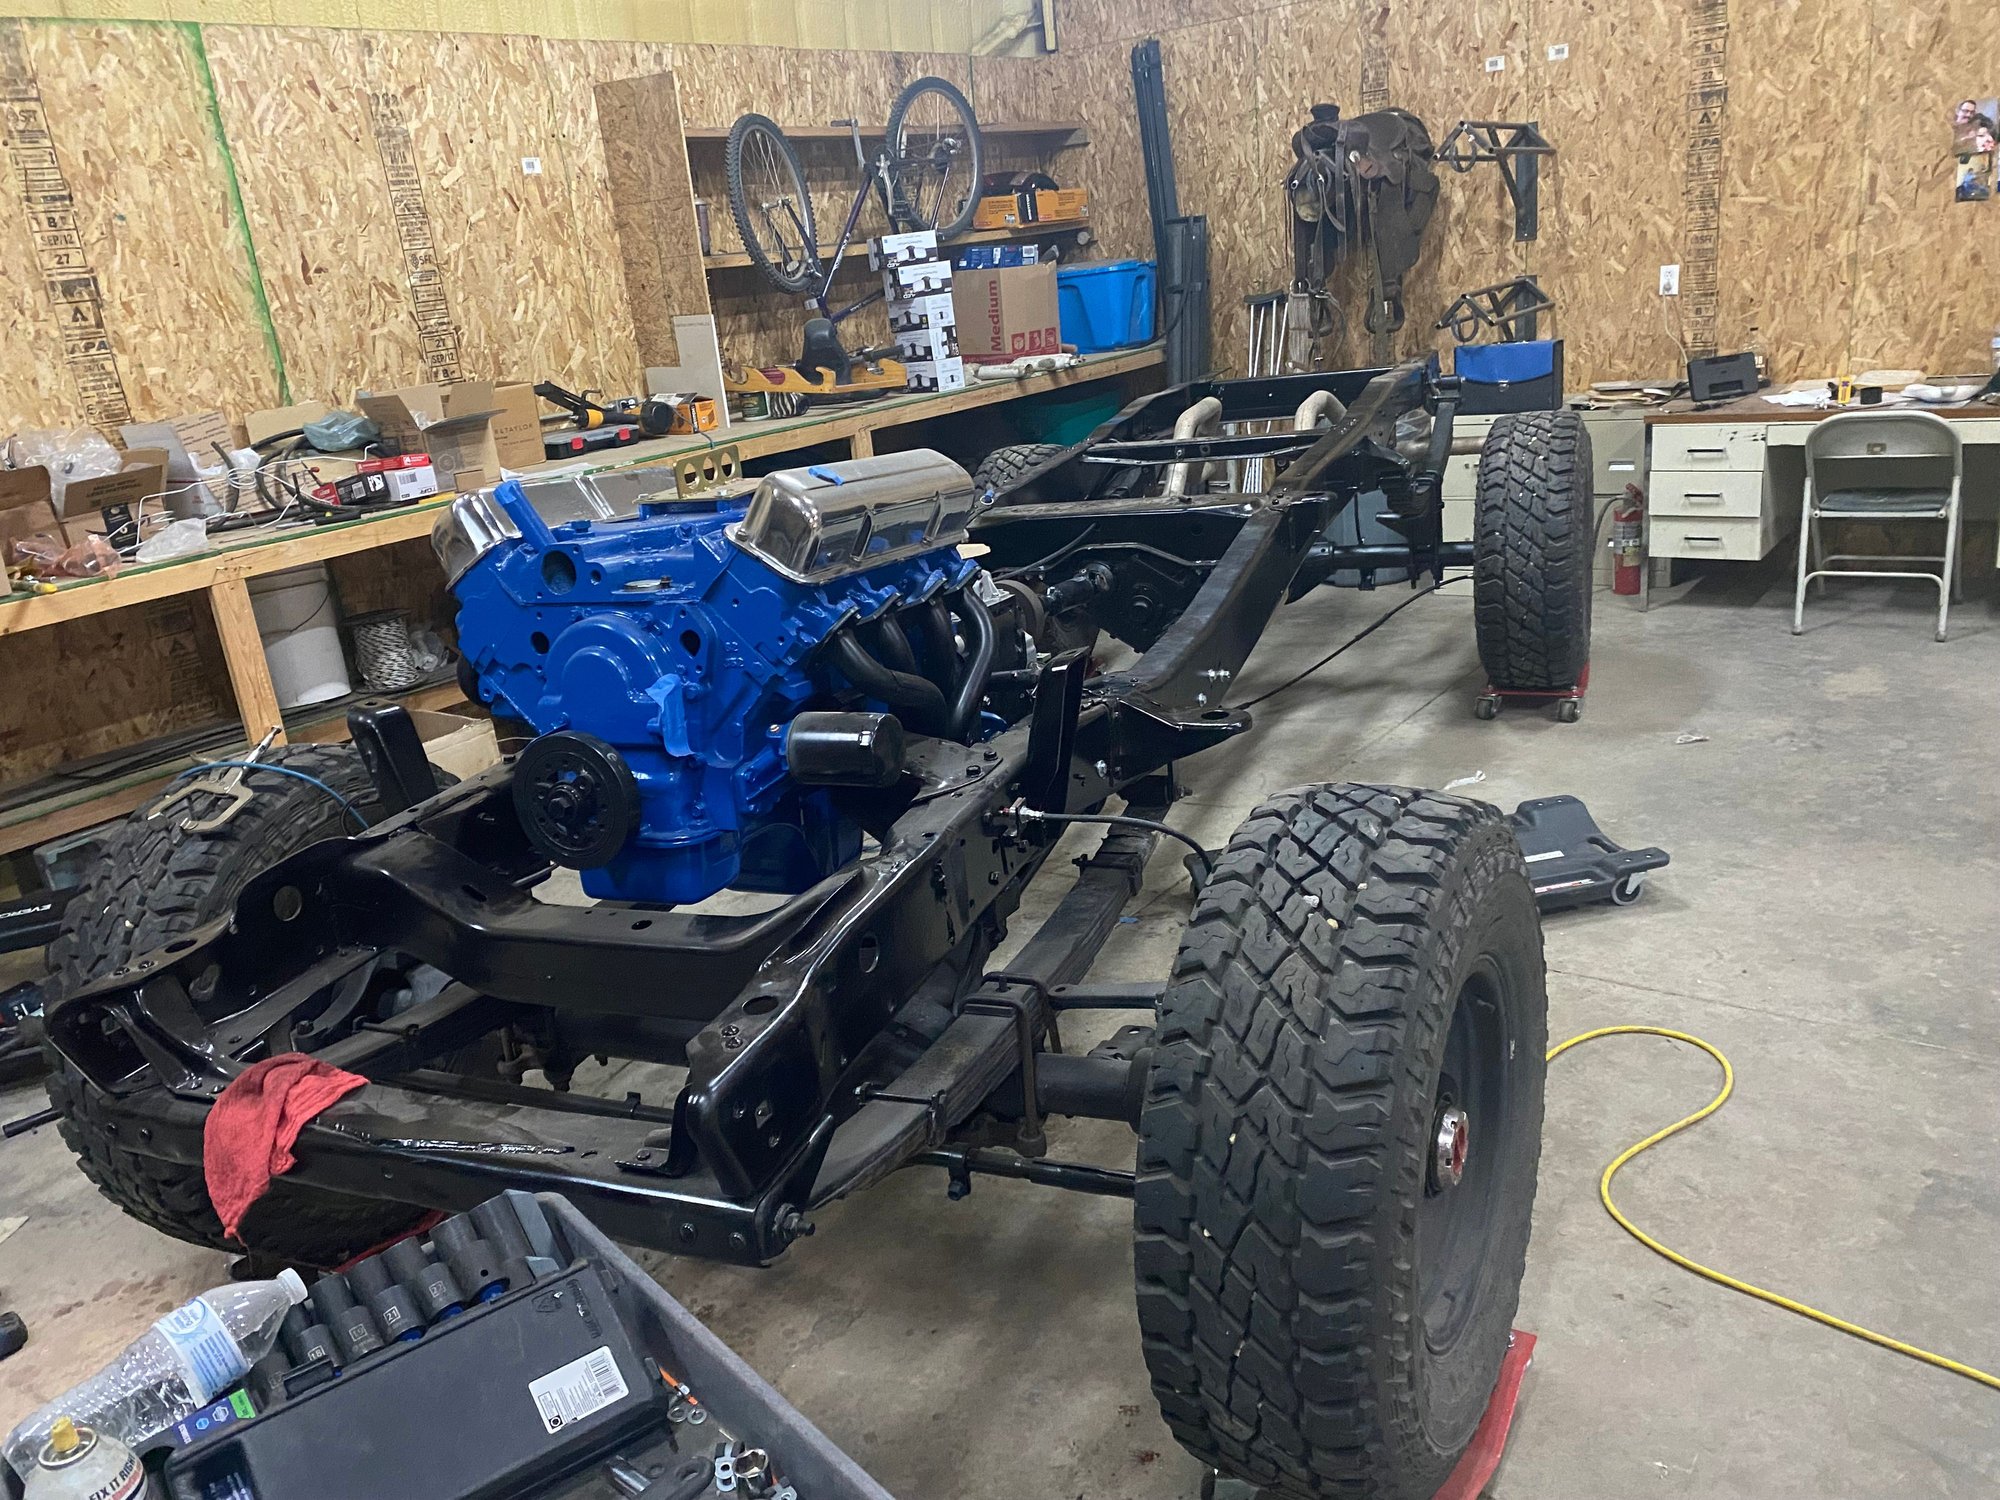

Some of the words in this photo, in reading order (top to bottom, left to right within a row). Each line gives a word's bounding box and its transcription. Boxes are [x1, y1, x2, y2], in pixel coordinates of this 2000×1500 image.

[40, 234, 76, 246] SEP/12
[54, 253, 70, 265] 27
[988, 280, 1002, 352] Medium
[434, 338, 446, 348] 27
[431, 352, 455, 363] SEP/12
[386, 1310, 398, 1322] 21
[353, 1327, 366, 1339] 19
[309, 1349, 323, 1361] 18
[89, 1487, 111, 1500] FIX
[109, 1476, 121, 1491] IT
[119, 1452, 136, 1481] RIGHT
